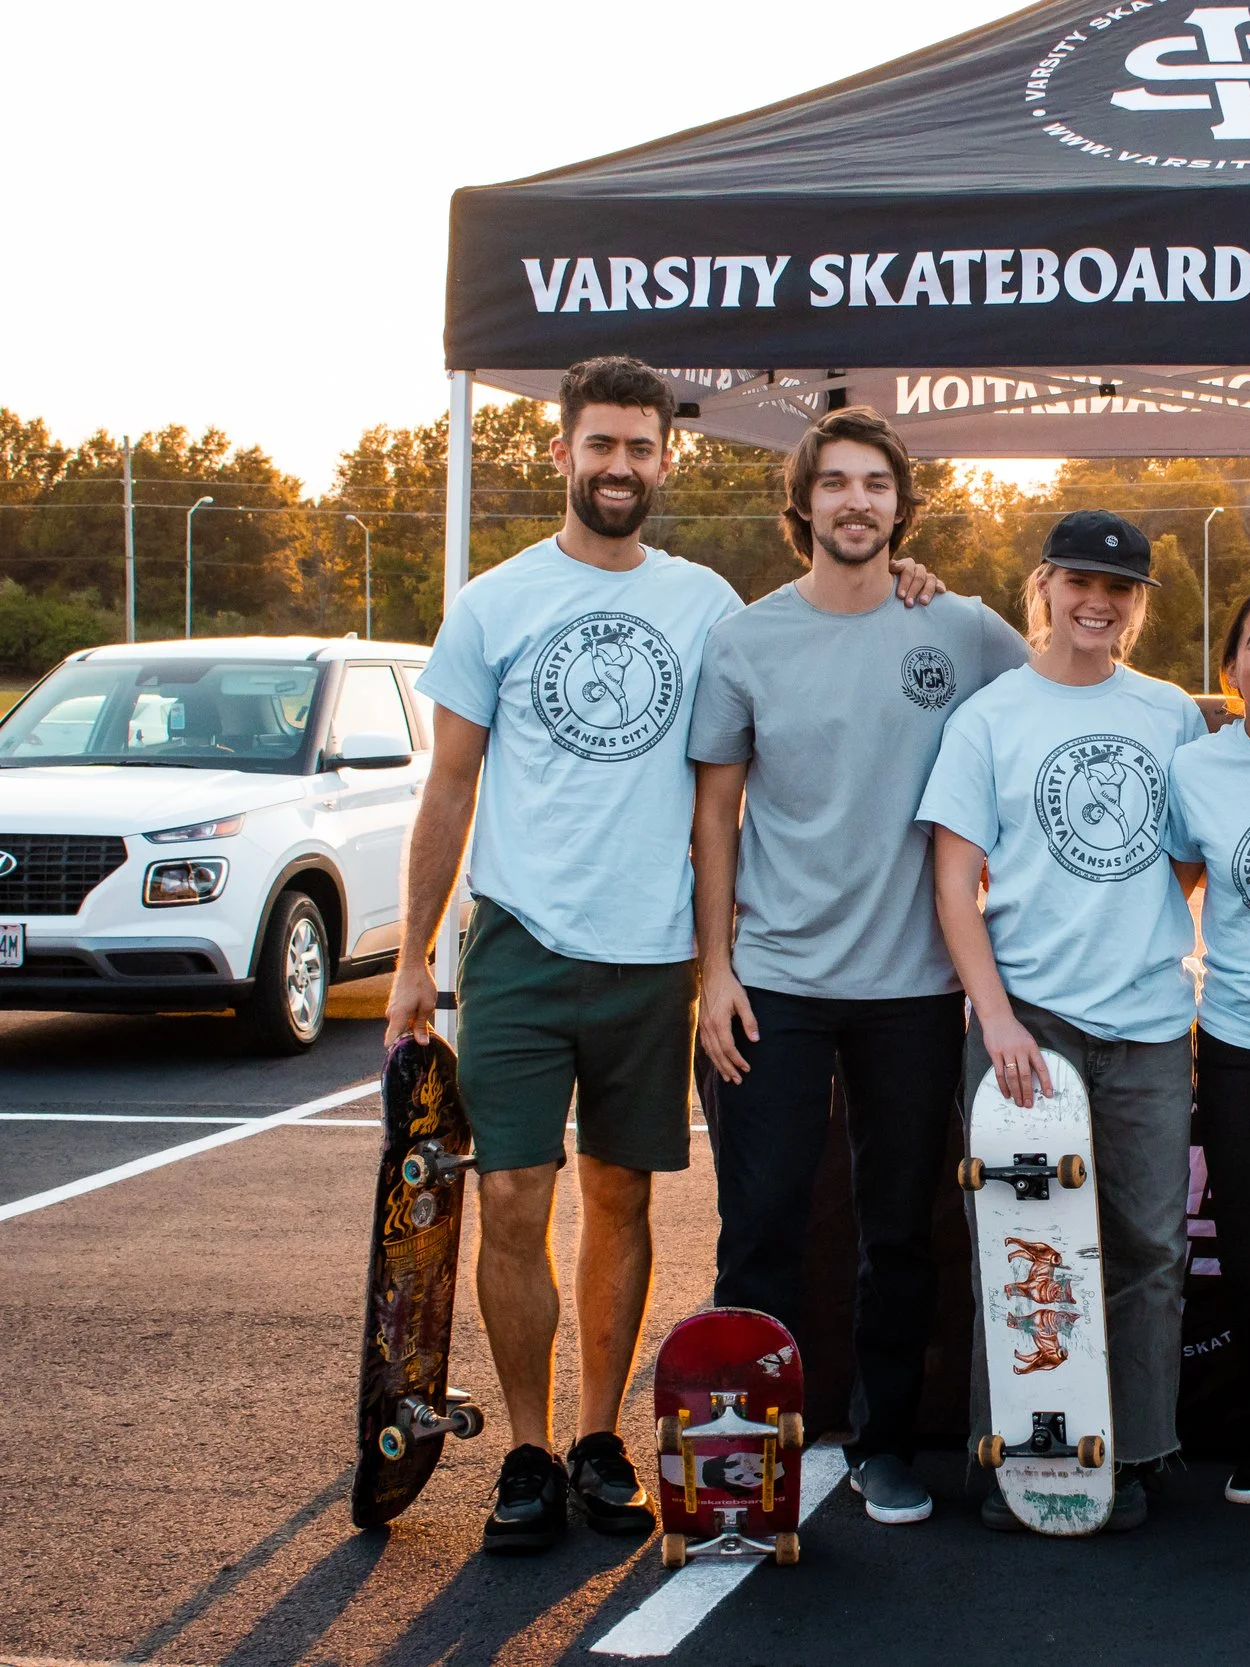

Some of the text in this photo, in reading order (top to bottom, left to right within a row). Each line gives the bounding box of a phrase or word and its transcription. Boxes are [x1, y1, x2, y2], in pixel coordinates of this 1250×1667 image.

[1025, 30, 1088, 102] VARSITY
[1089, 0, 1168, 30] SKA
[521, 255, 792, 313] VARSITY
[543, 622, 673, 719] VARSITY SKATE ACADEMY
[563, 724, 650, 748] KANSAS CITY
[1047, 764, 1067, 842] VARSITY
[1068, 743, 1125, 761] SKATE
[1069, 841, 1146, 869] KANSAS CITY
